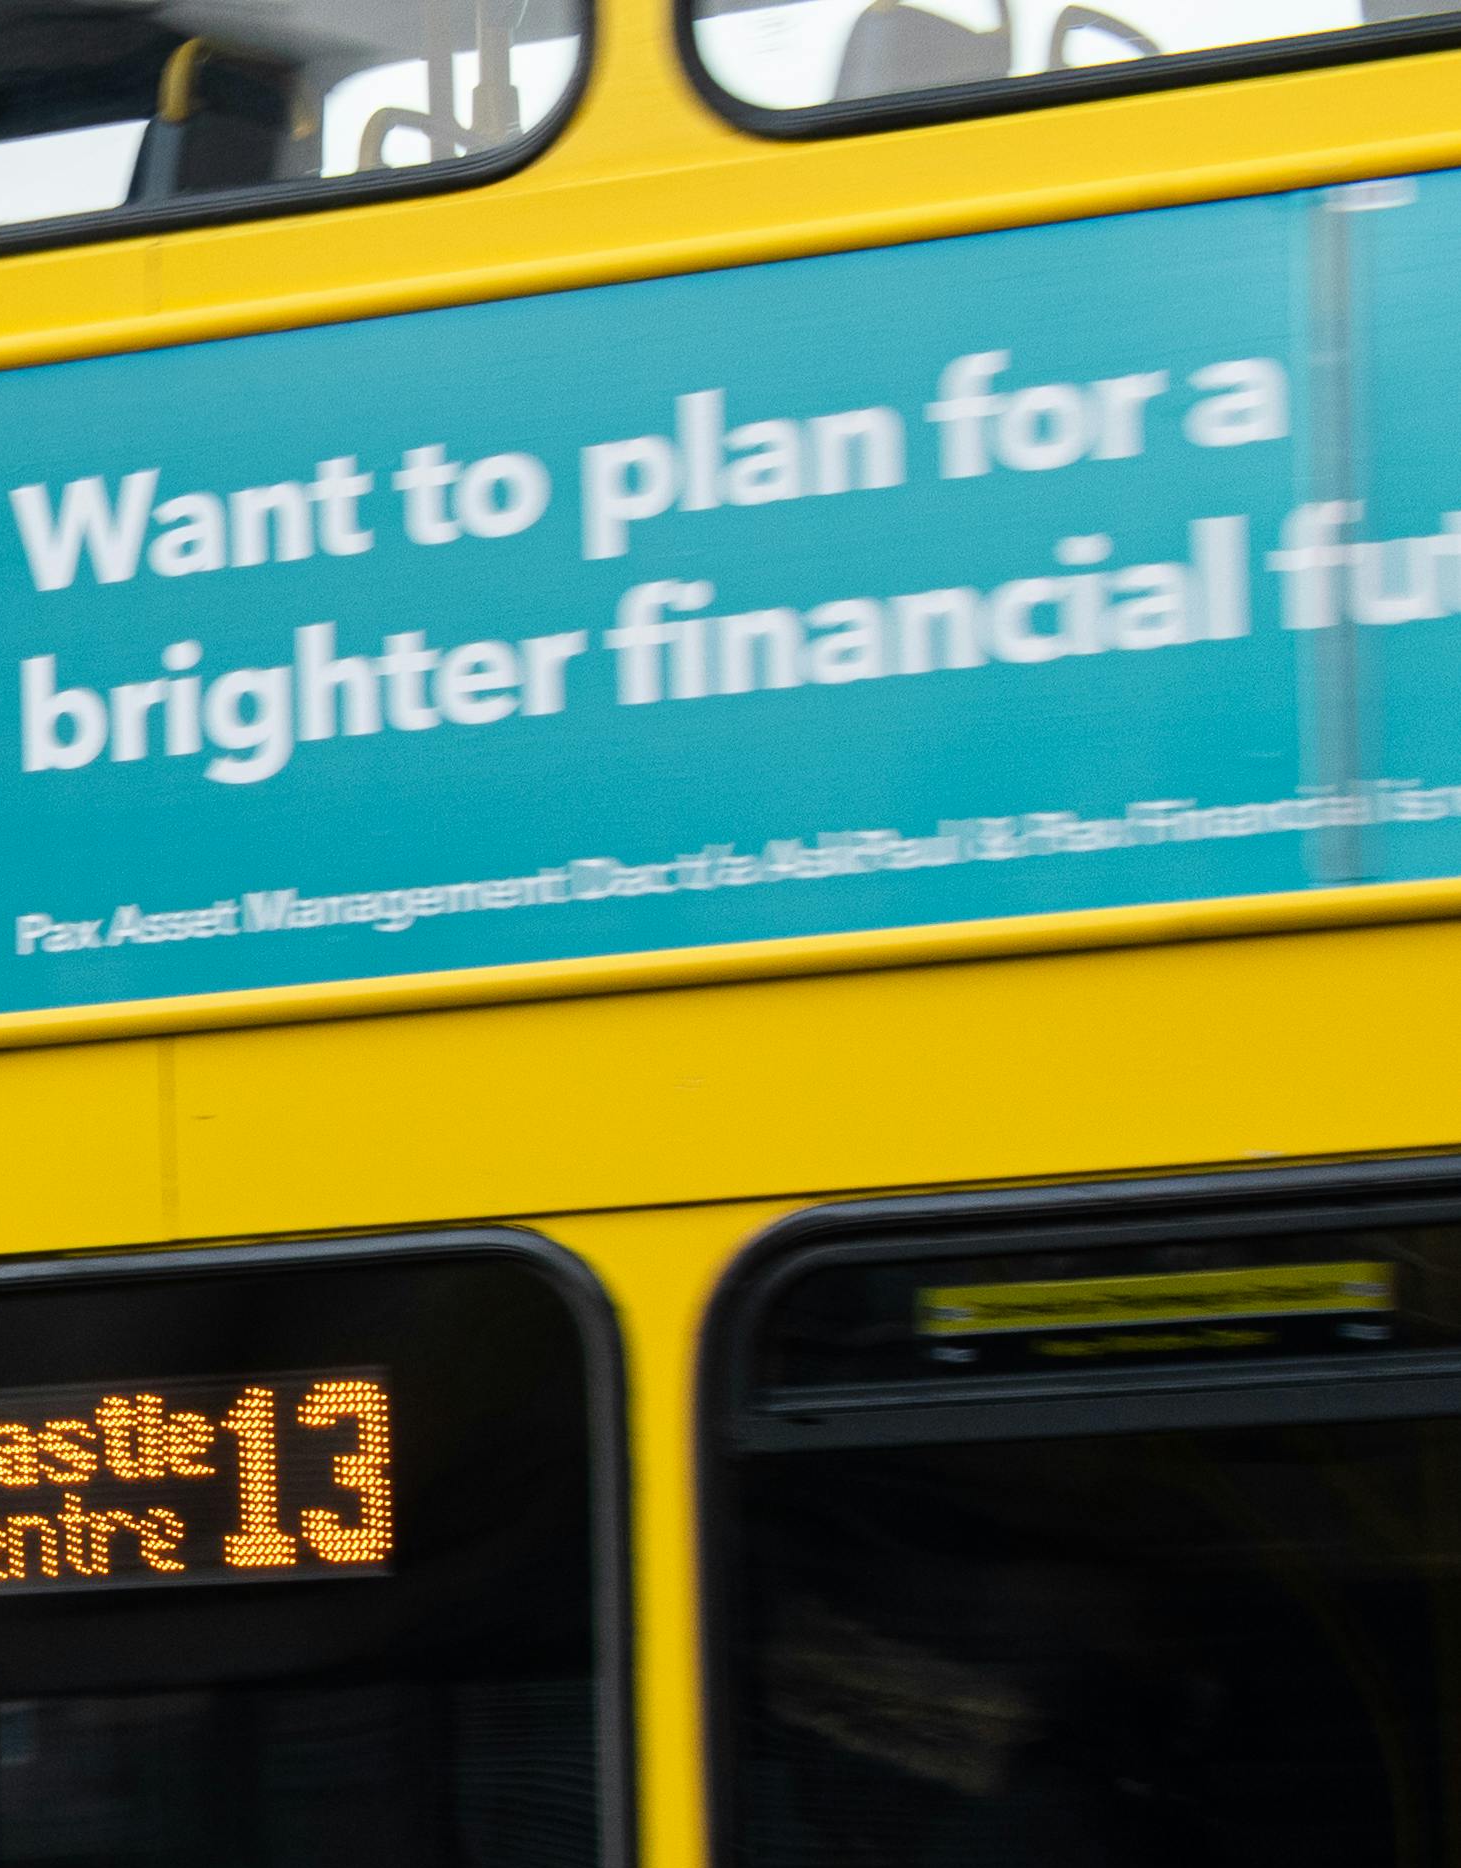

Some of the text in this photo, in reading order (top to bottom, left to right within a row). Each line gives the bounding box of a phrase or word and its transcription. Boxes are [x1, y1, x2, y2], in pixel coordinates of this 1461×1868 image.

[11, 349, 1291, 592] Want to plan for a
[19, 620, 588, 786] brighter
[605, 514, 1251, 708] financial
[14, 911, 105, 956] Pax
[103, 898, 240, 946] Asset
[240, 867, 570, 933] Management
[220, 1380, 395, 1567] 13
